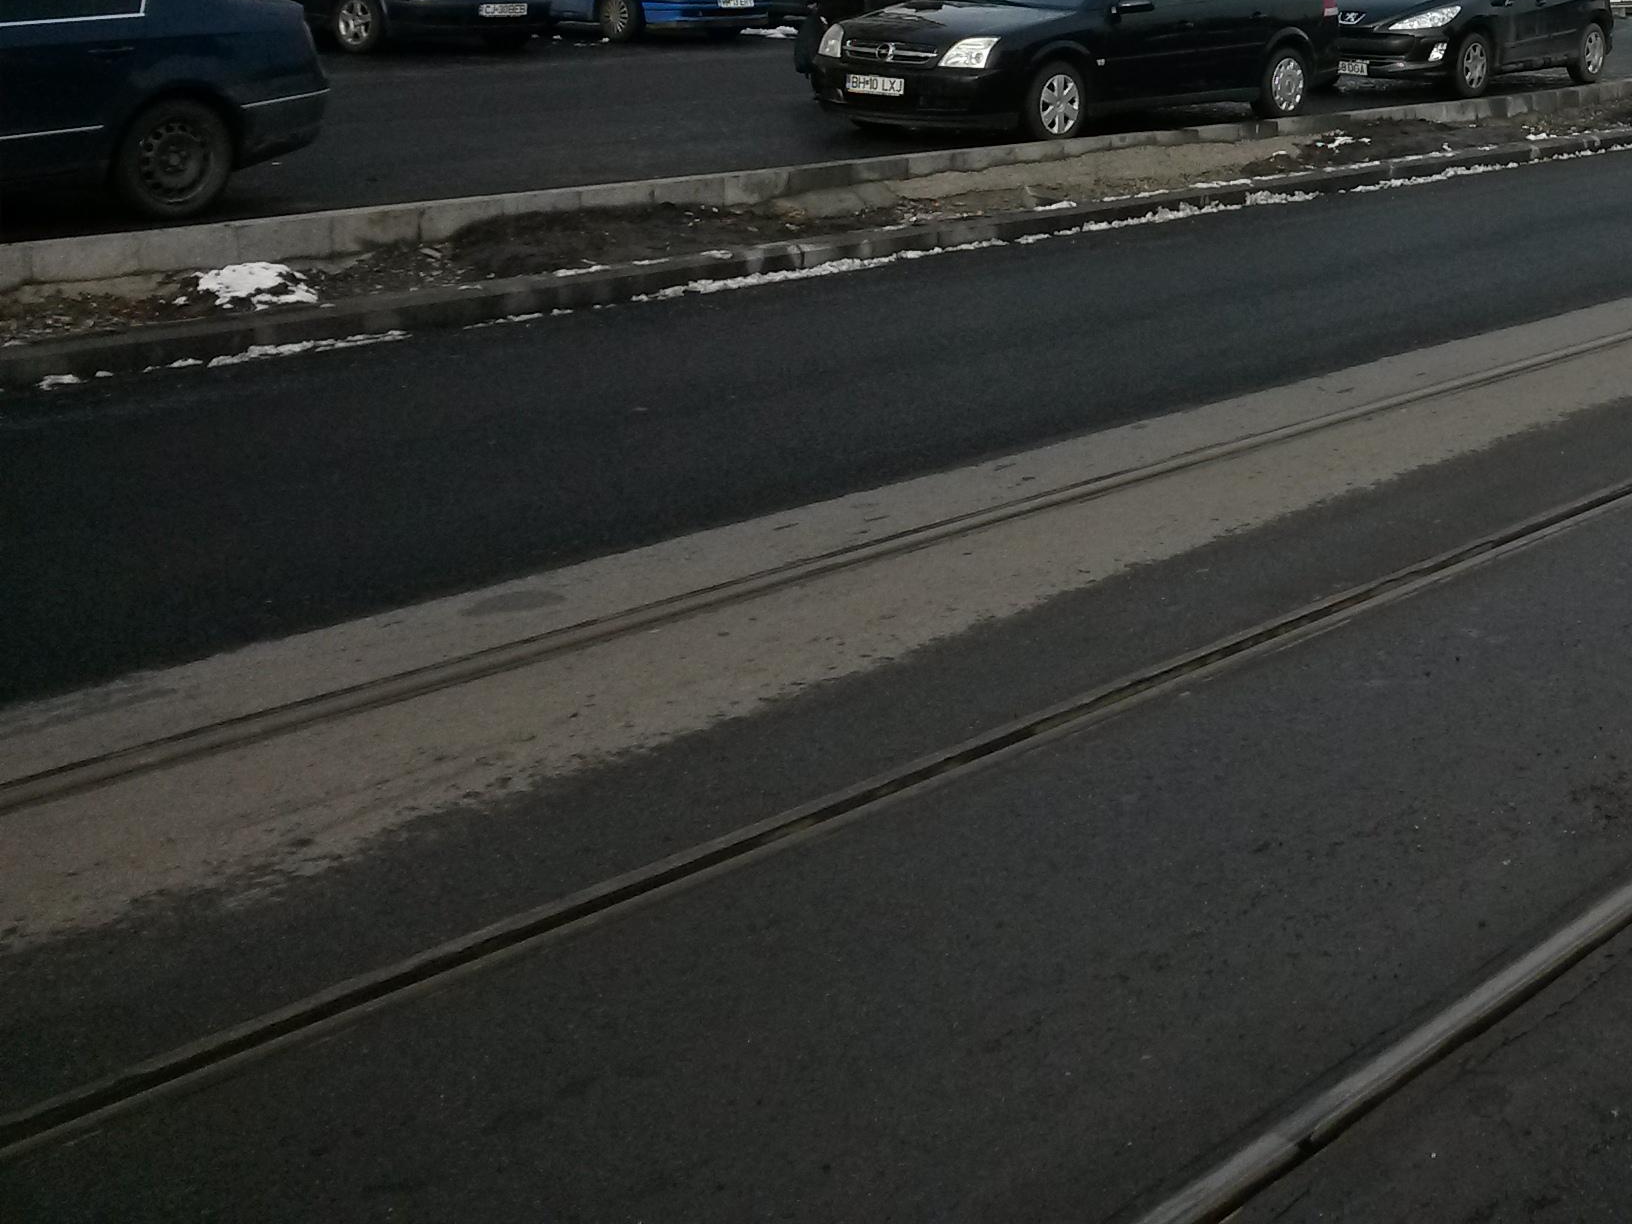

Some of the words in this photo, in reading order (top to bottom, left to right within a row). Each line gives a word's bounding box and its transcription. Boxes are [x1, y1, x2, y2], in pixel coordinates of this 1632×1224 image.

[851, 76, 866, 89] BH
[869, 78, 879, 91] 10
[881, 79, 903, 93] LXJ
